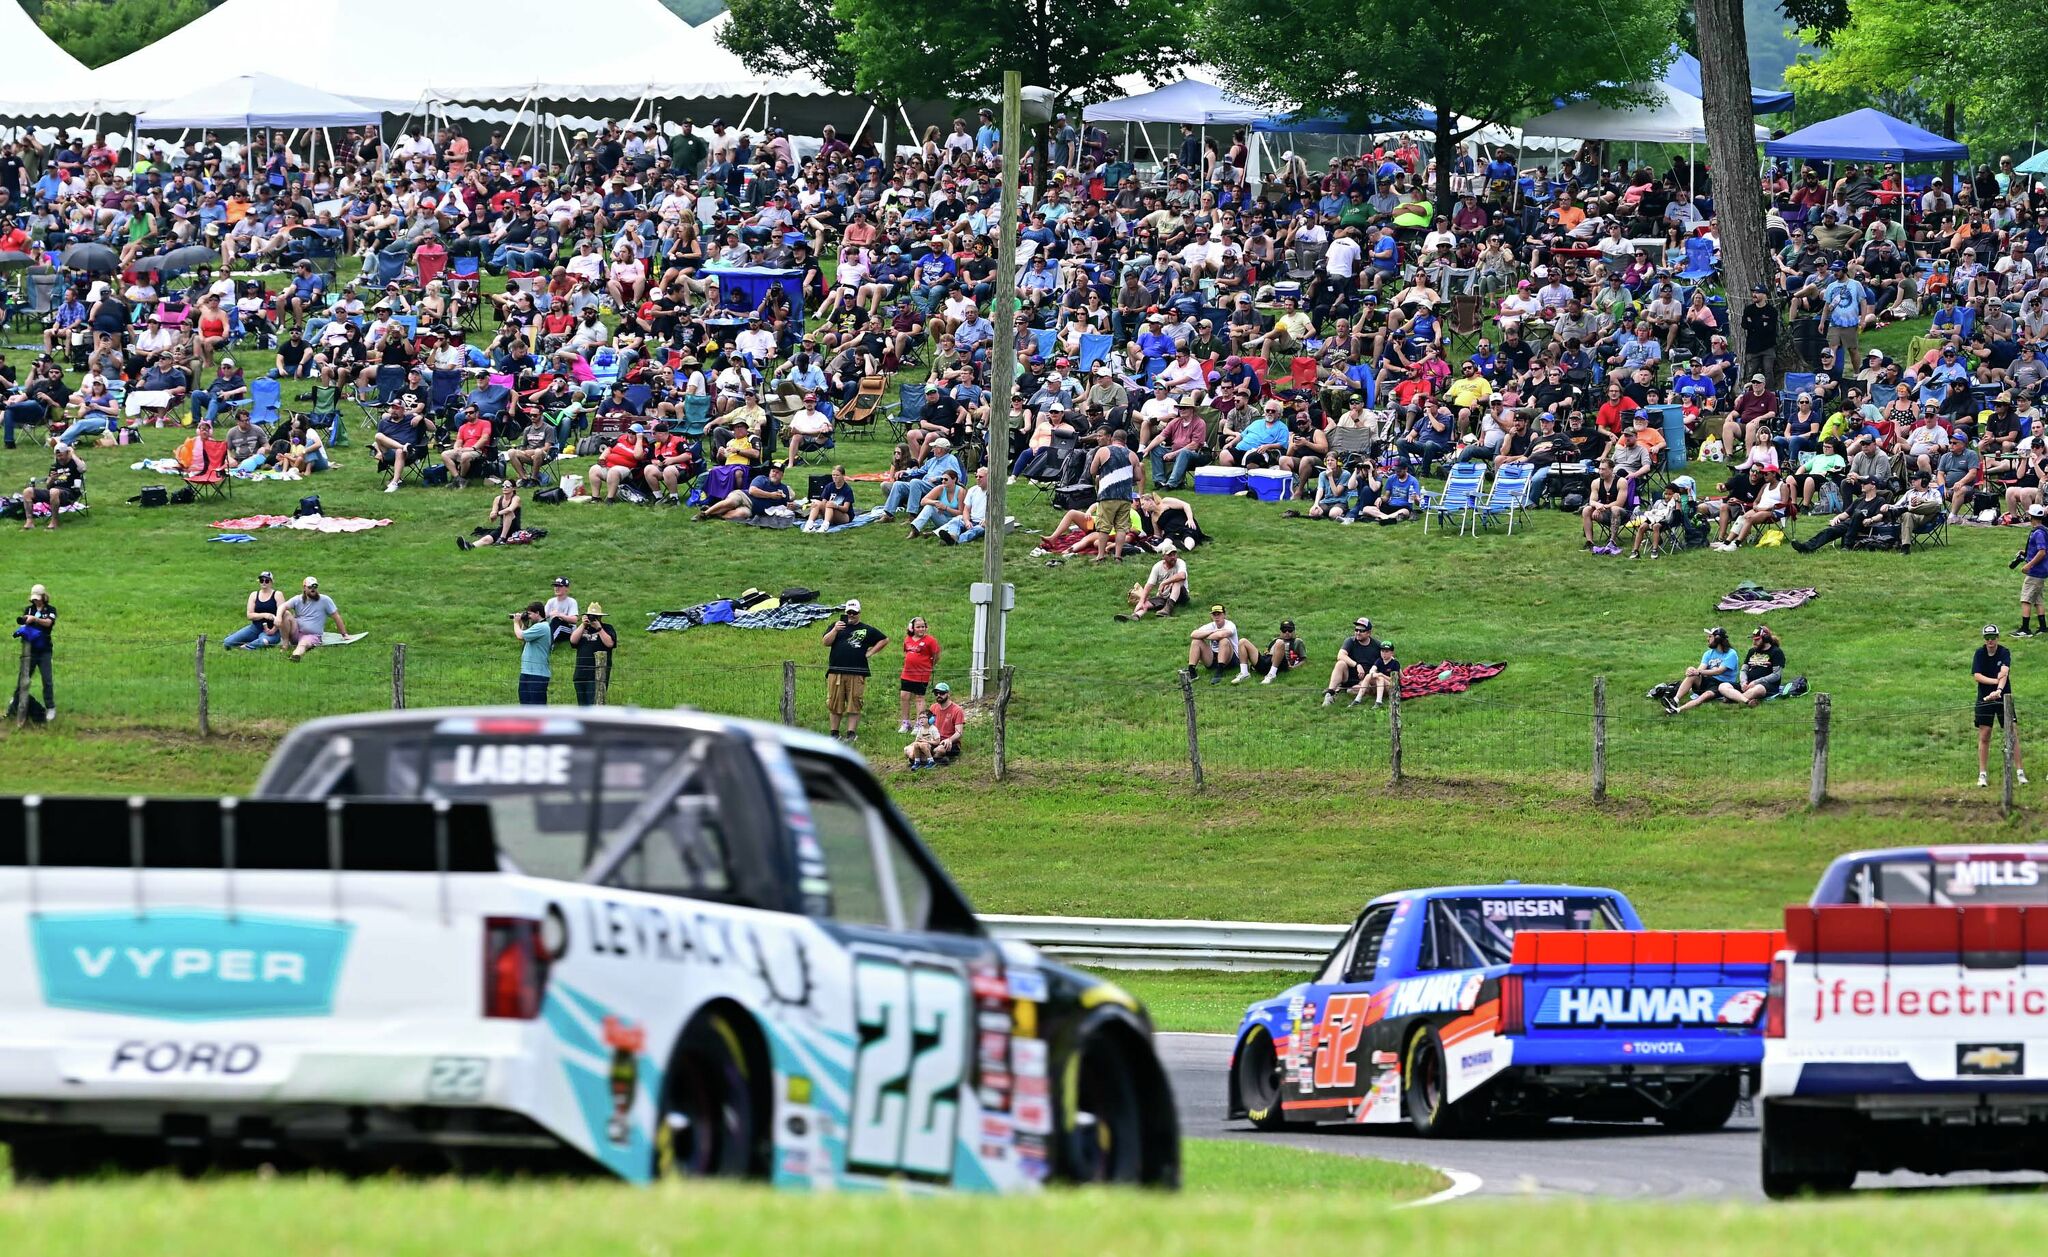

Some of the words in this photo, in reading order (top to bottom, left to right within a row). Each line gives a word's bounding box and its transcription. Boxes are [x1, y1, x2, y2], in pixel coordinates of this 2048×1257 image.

[456, 745, 571, 783] LABBE
[1956, 862, 2039, 885] MILLS
[1482, 900, 1565, 916] FRIESEN
[74, 947, 305, 983] VYPER
[1392, 975, 1461, 1017] HALMAR
[1559, 988, 1714, 1022] HALMAR
[1814, 979, 2046, 1022] jfelectric
[110, 1041, 261, 1075] FORD
[1316, 995, 1369, 1087] 52
[1634, 1042, 1685, 1054] TOYOTA
[430, 1058, 486, 1098] 22
[847, 950, 968, 1182] 22
